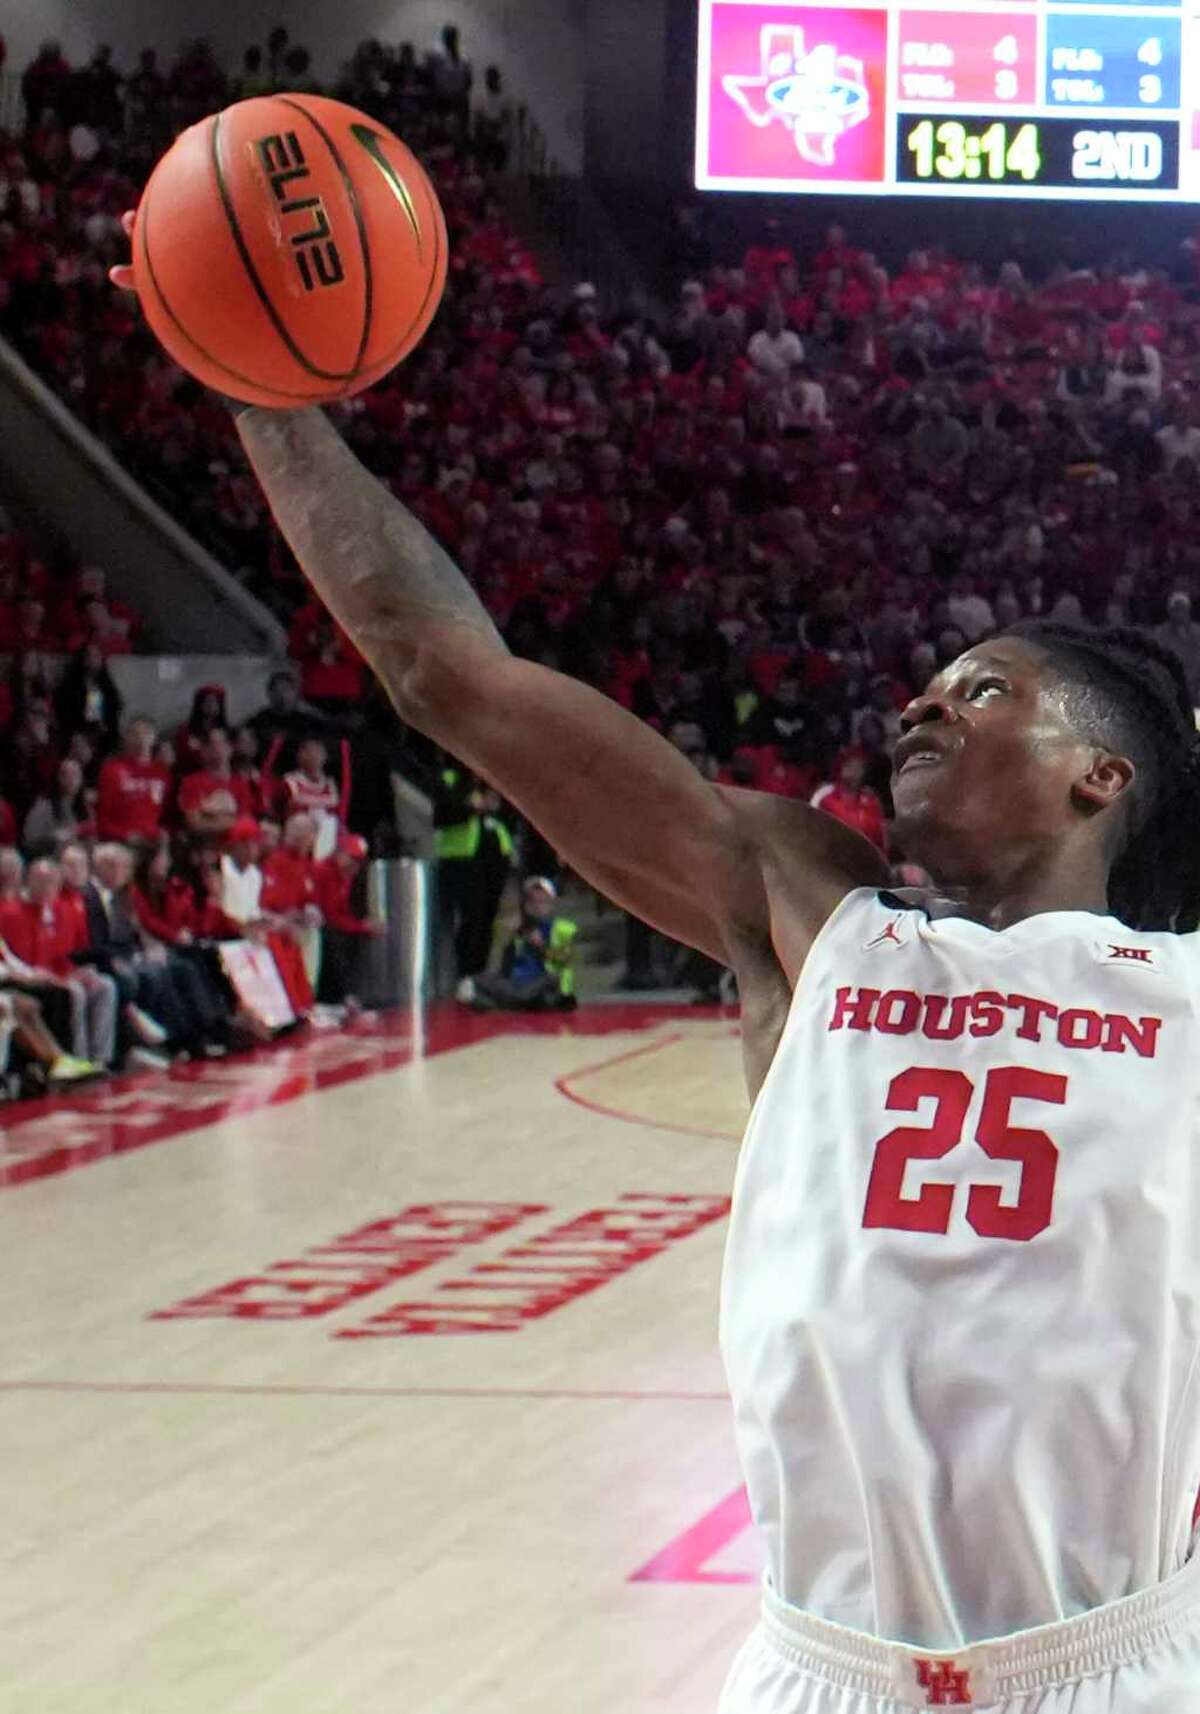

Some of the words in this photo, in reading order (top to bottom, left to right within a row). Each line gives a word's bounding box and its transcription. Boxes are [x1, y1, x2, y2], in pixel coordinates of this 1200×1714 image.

[909, 121, 1041, 180] 13:14
[1073, 131, 1163, 181] 2ND
[258, 131, 346, 292] ELITE
[829, 986, 1162, 1058] HOUSTON
[862, 1066, 1068, 1241] 25
